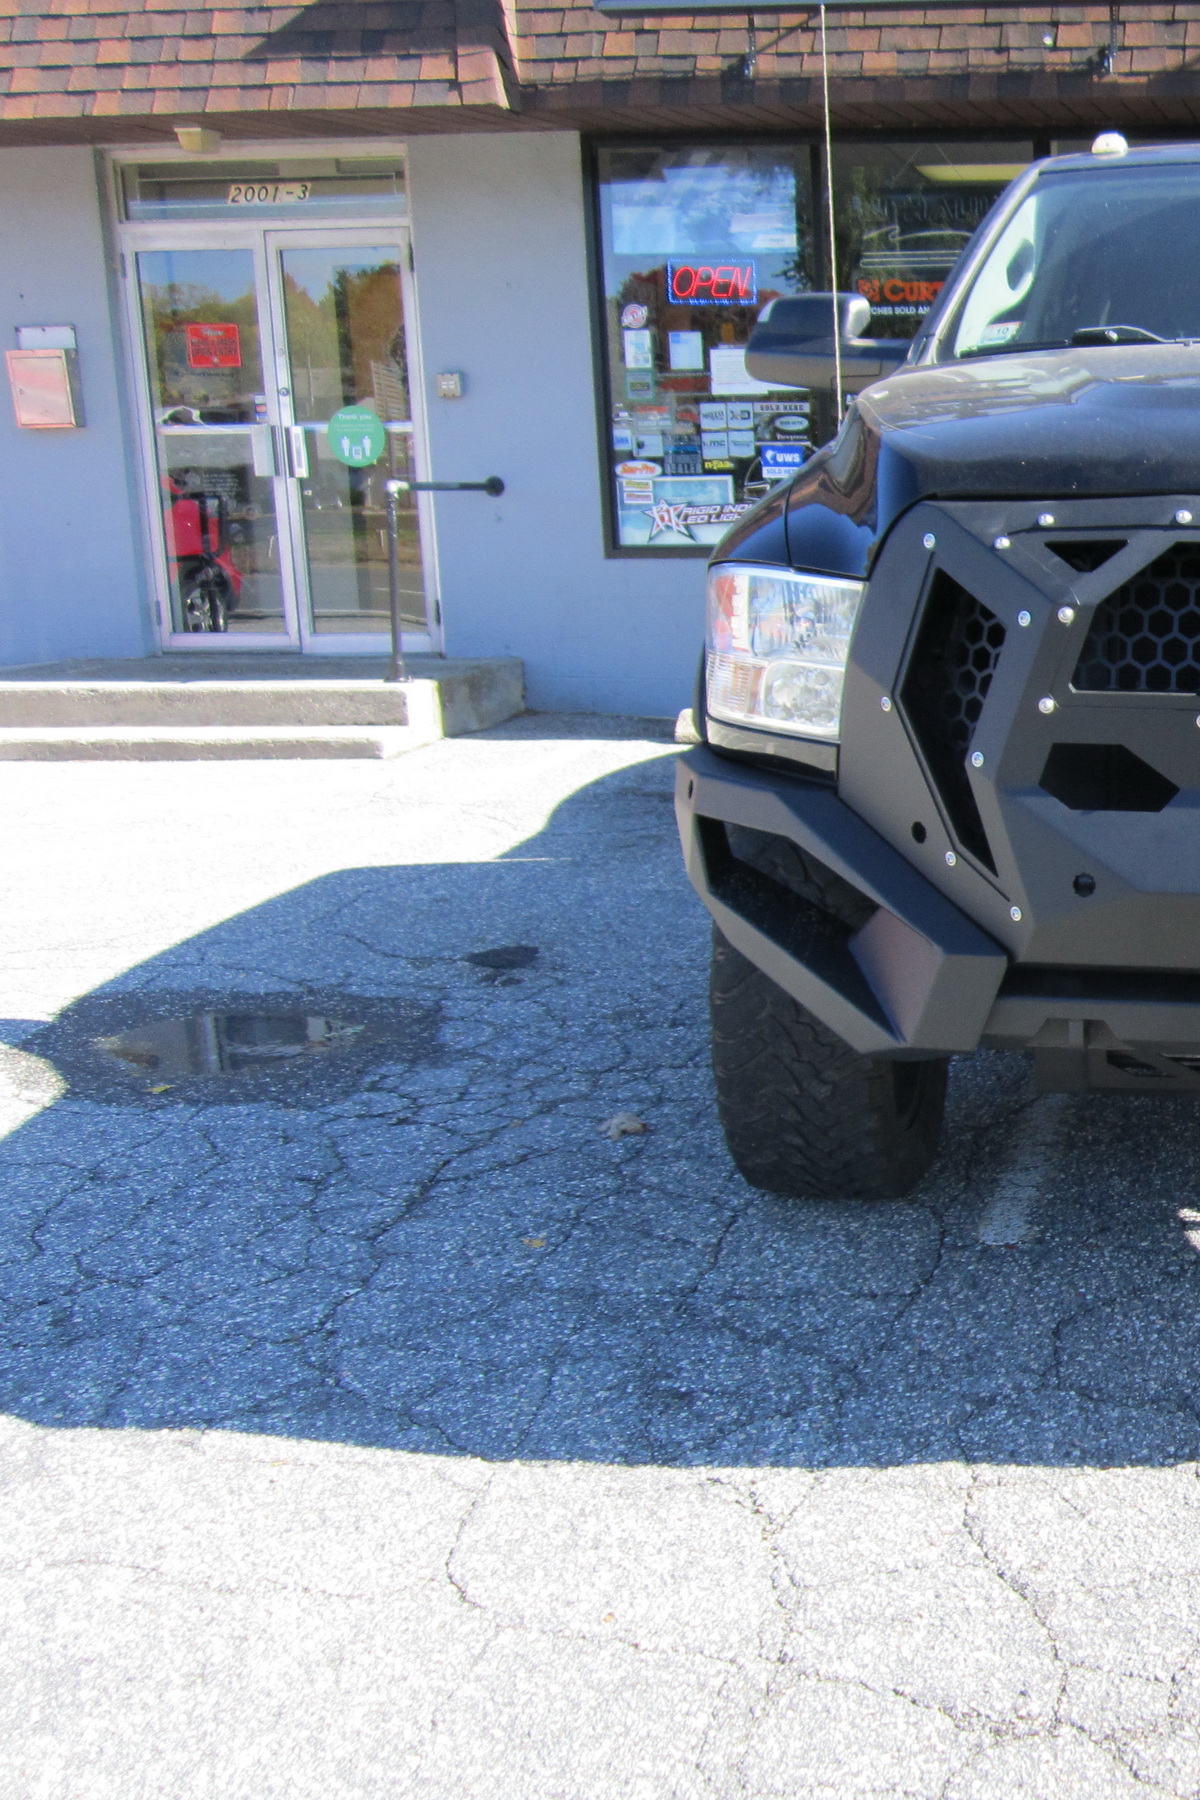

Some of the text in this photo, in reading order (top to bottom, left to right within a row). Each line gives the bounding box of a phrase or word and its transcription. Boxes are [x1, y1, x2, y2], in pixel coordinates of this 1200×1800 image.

[231, 184, 308, 203] 2001-3
[673, 266, 751, 297] OPEN
[870, 306, 931, 315] CHES SOLD AN
[776, 453, 800, 462] UWS
[683, 505, 721, 514] RIGID
